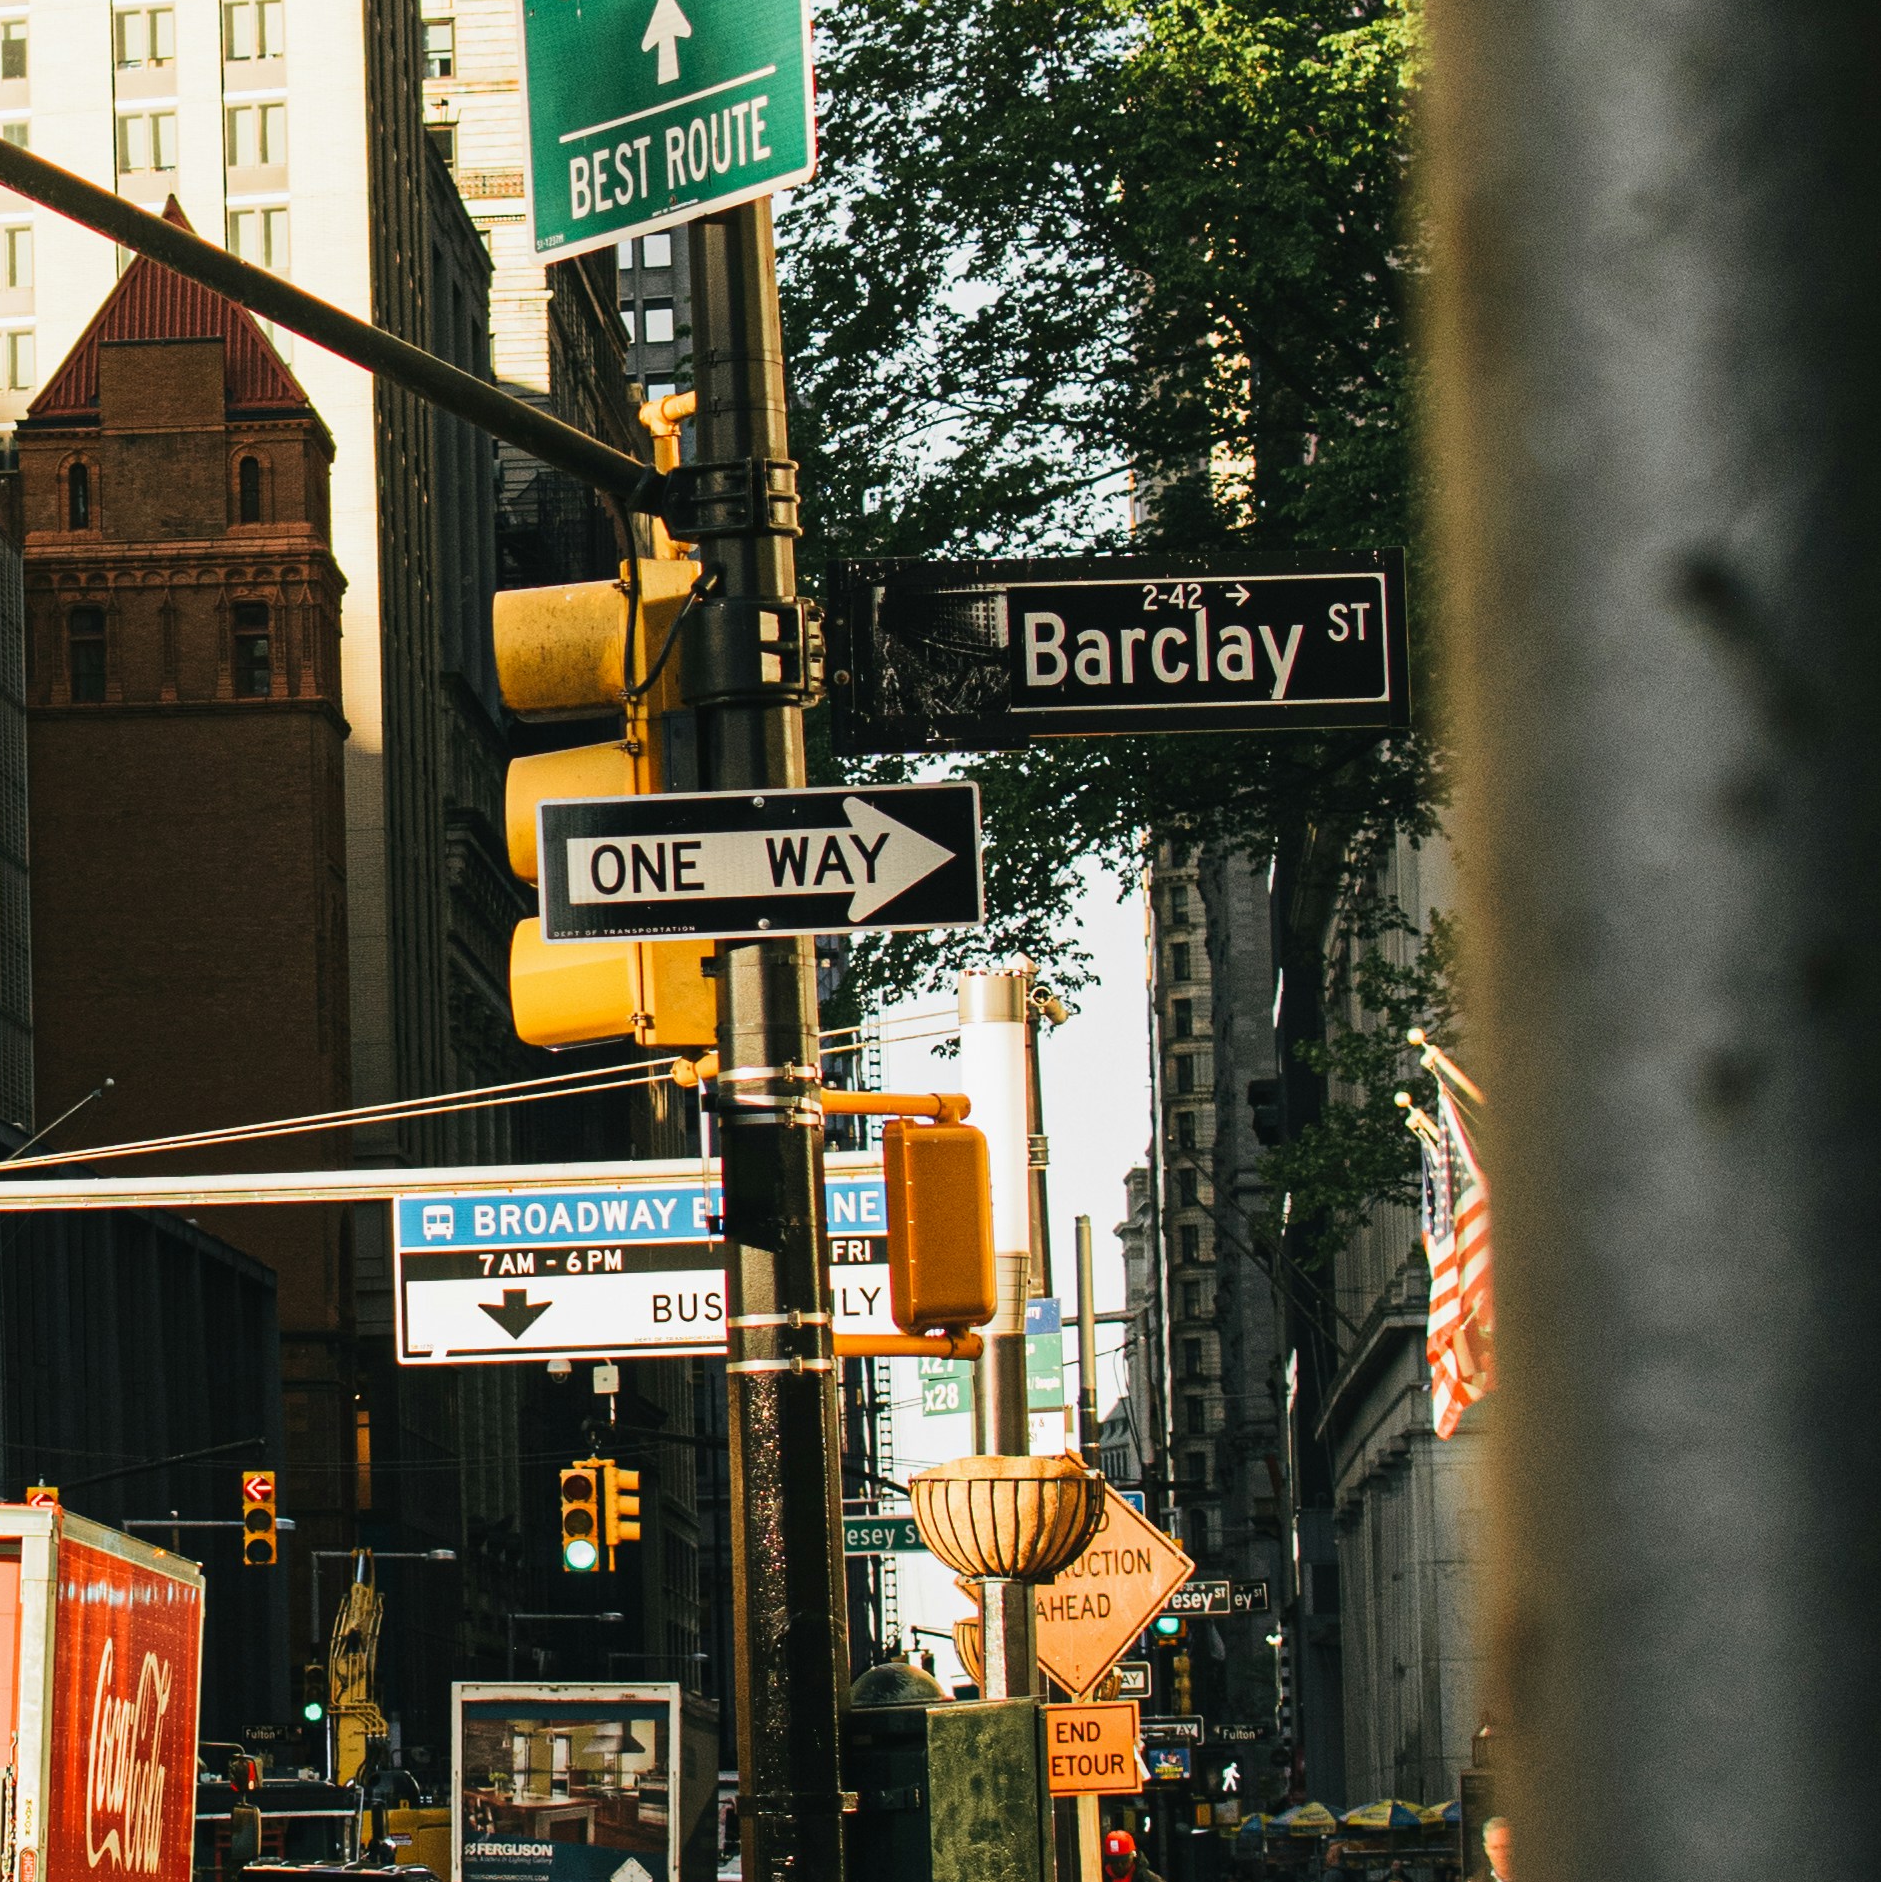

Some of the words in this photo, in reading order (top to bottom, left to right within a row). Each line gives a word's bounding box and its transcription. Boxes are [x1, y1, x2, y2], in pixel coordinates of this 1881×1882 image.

[570, 133, 652, 220] BEST
[665, 94, 771, 190] ROUTE
[1141, 581, 1203, 612] 2-42
[1023, 605, 1303, 700] Barclay
[1327, 602, 1372, 644] ST
[590, 839, 706, 897] ONE
[766, 832, 891, 889] WAY
[553, 930, 580, 938] DEPT
[585, 929, 598, 937] OF
[604, 925, 696, 935] TRANSPORTATION
[474, 1197, 678, 1238] BROADWAY
[831, 1239, 871, 1263] FRI
[1214, 1586, 1227, 1599] ST
[1035, 1593, 1112, 1622] AHEAD
[246, 1730, 276, 1739] Fulton
[1056, 1721, 1101, 1744] END
[1223, 1727, 1256, 1740] Fulton
[477, 1843, 553, 1857] FERGUSON
